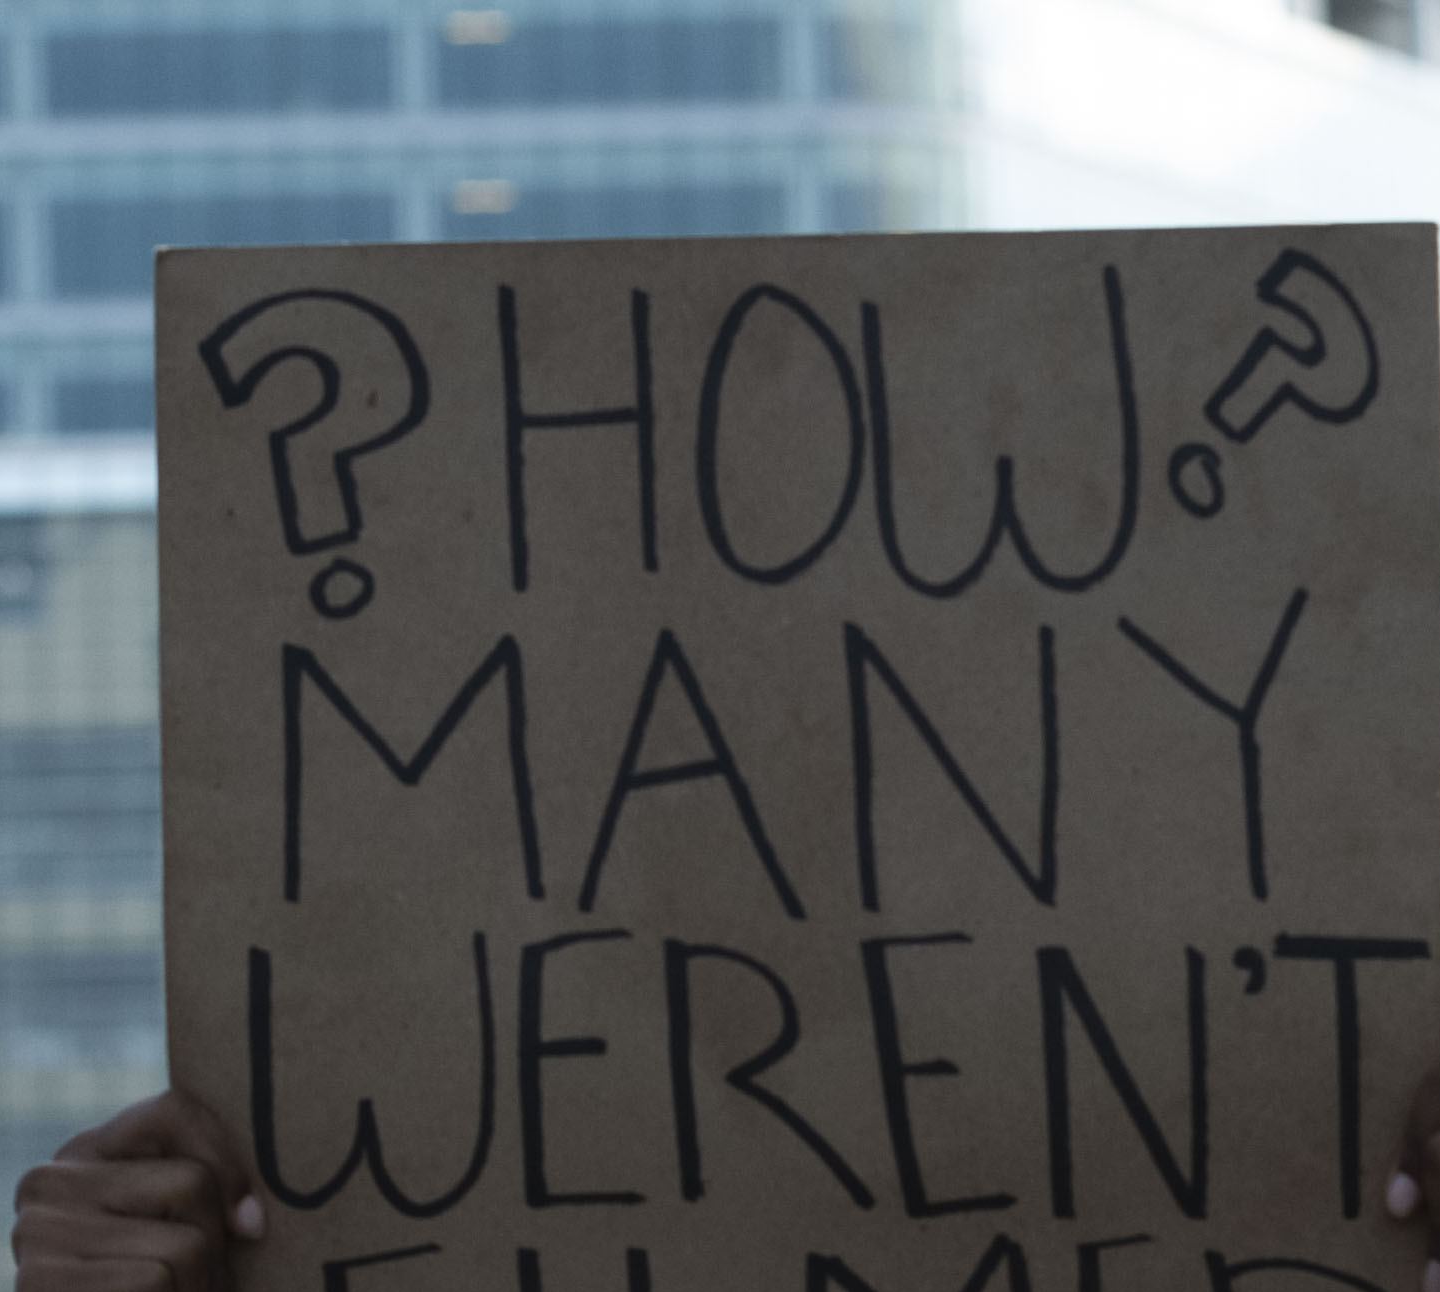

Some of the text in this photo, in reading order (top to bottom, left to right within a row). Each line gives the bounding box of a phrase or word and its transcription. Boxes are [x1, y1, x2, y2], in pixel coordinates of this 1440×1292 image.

[497, 264, 1141, 600] HOW
[280, 588, 1309, 922] MANY
[247, 928, 1432, 1222] WEREN'T
